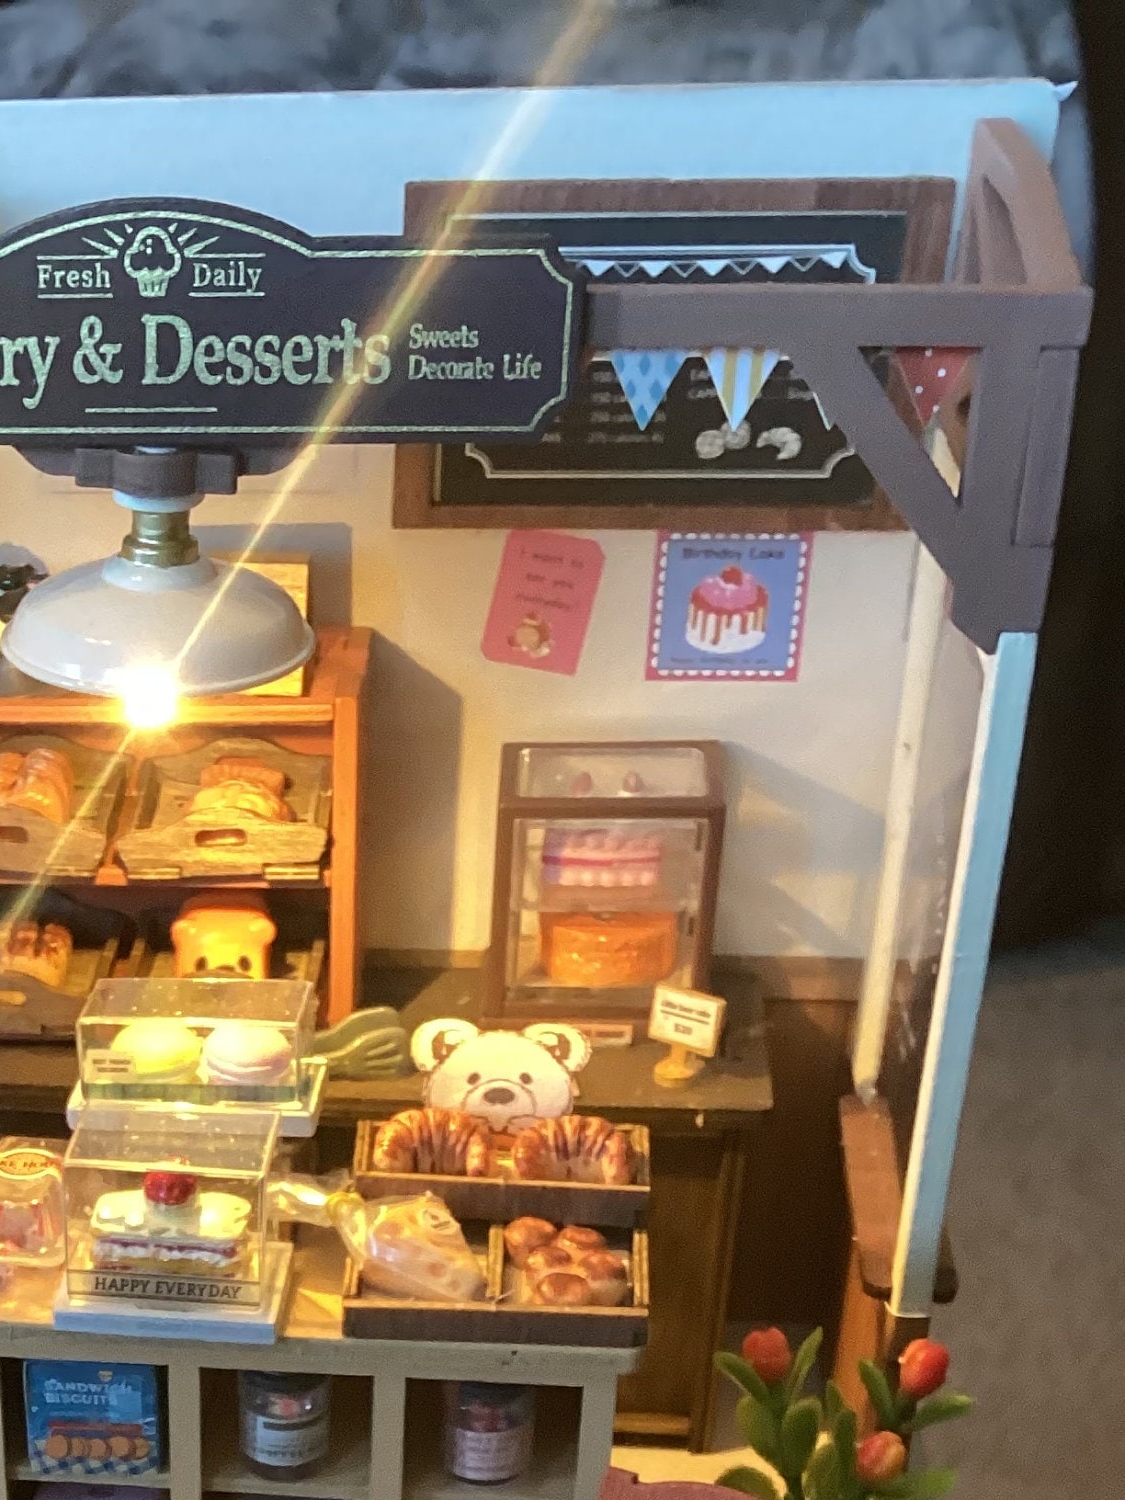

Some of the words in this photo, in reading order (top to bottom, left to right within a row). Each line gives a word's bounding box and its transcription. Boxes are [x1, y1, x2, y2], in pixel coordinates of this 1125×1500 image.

[36, 262, 112, 289] Fresh
[192, 260, 263, 292] Daily
[72, 315, 124, 385] &
[140, 313, 393, 386] Desserts
[408, 322, 479, 349] Sweets
[407, 354, 495, 380] Decorate
[502, 352, 543, 380] Life
[94, 1276, 151, 1293] HAPPY
[154, 1280, 242, 1300] EVERYDAY
